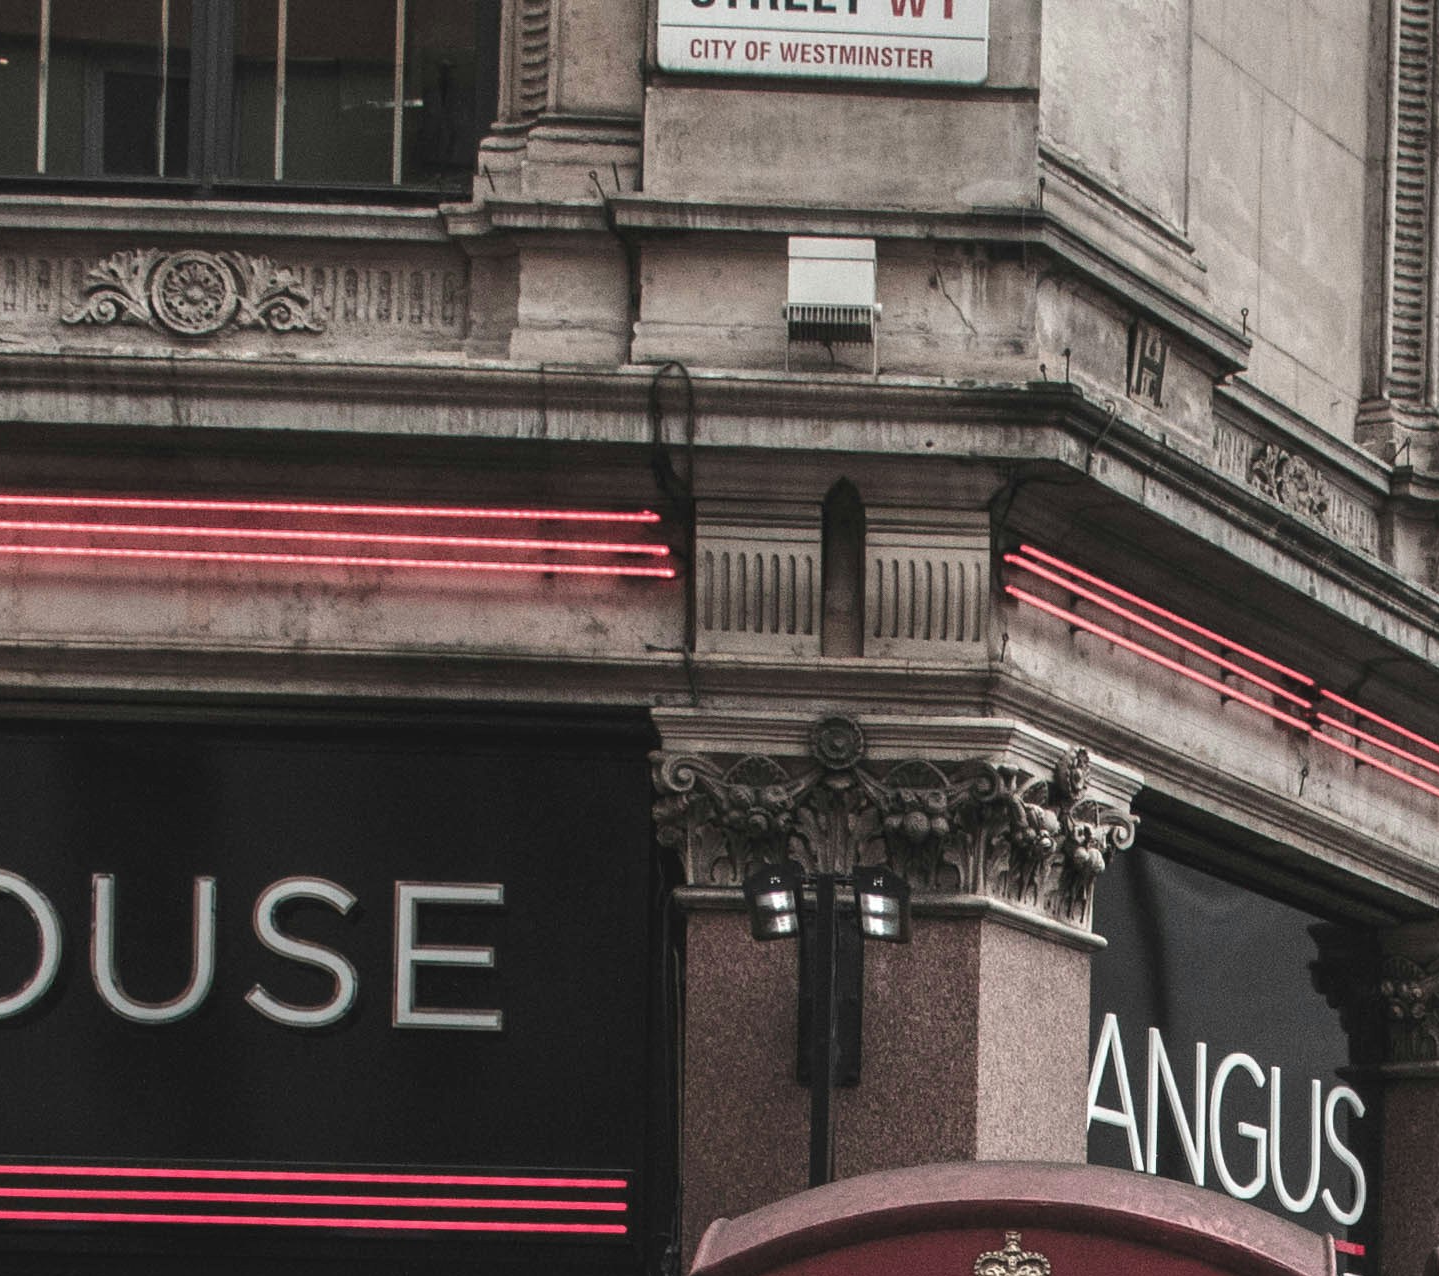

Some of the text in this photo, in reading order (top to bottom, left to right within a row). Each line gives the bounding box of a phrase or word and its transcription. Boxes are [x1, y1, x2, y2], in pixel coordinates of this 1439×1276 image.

[690, 38, 934, 69] CITY OF WESTMINSTER
[1086, 1012, 1367, 1226] ANGUS
